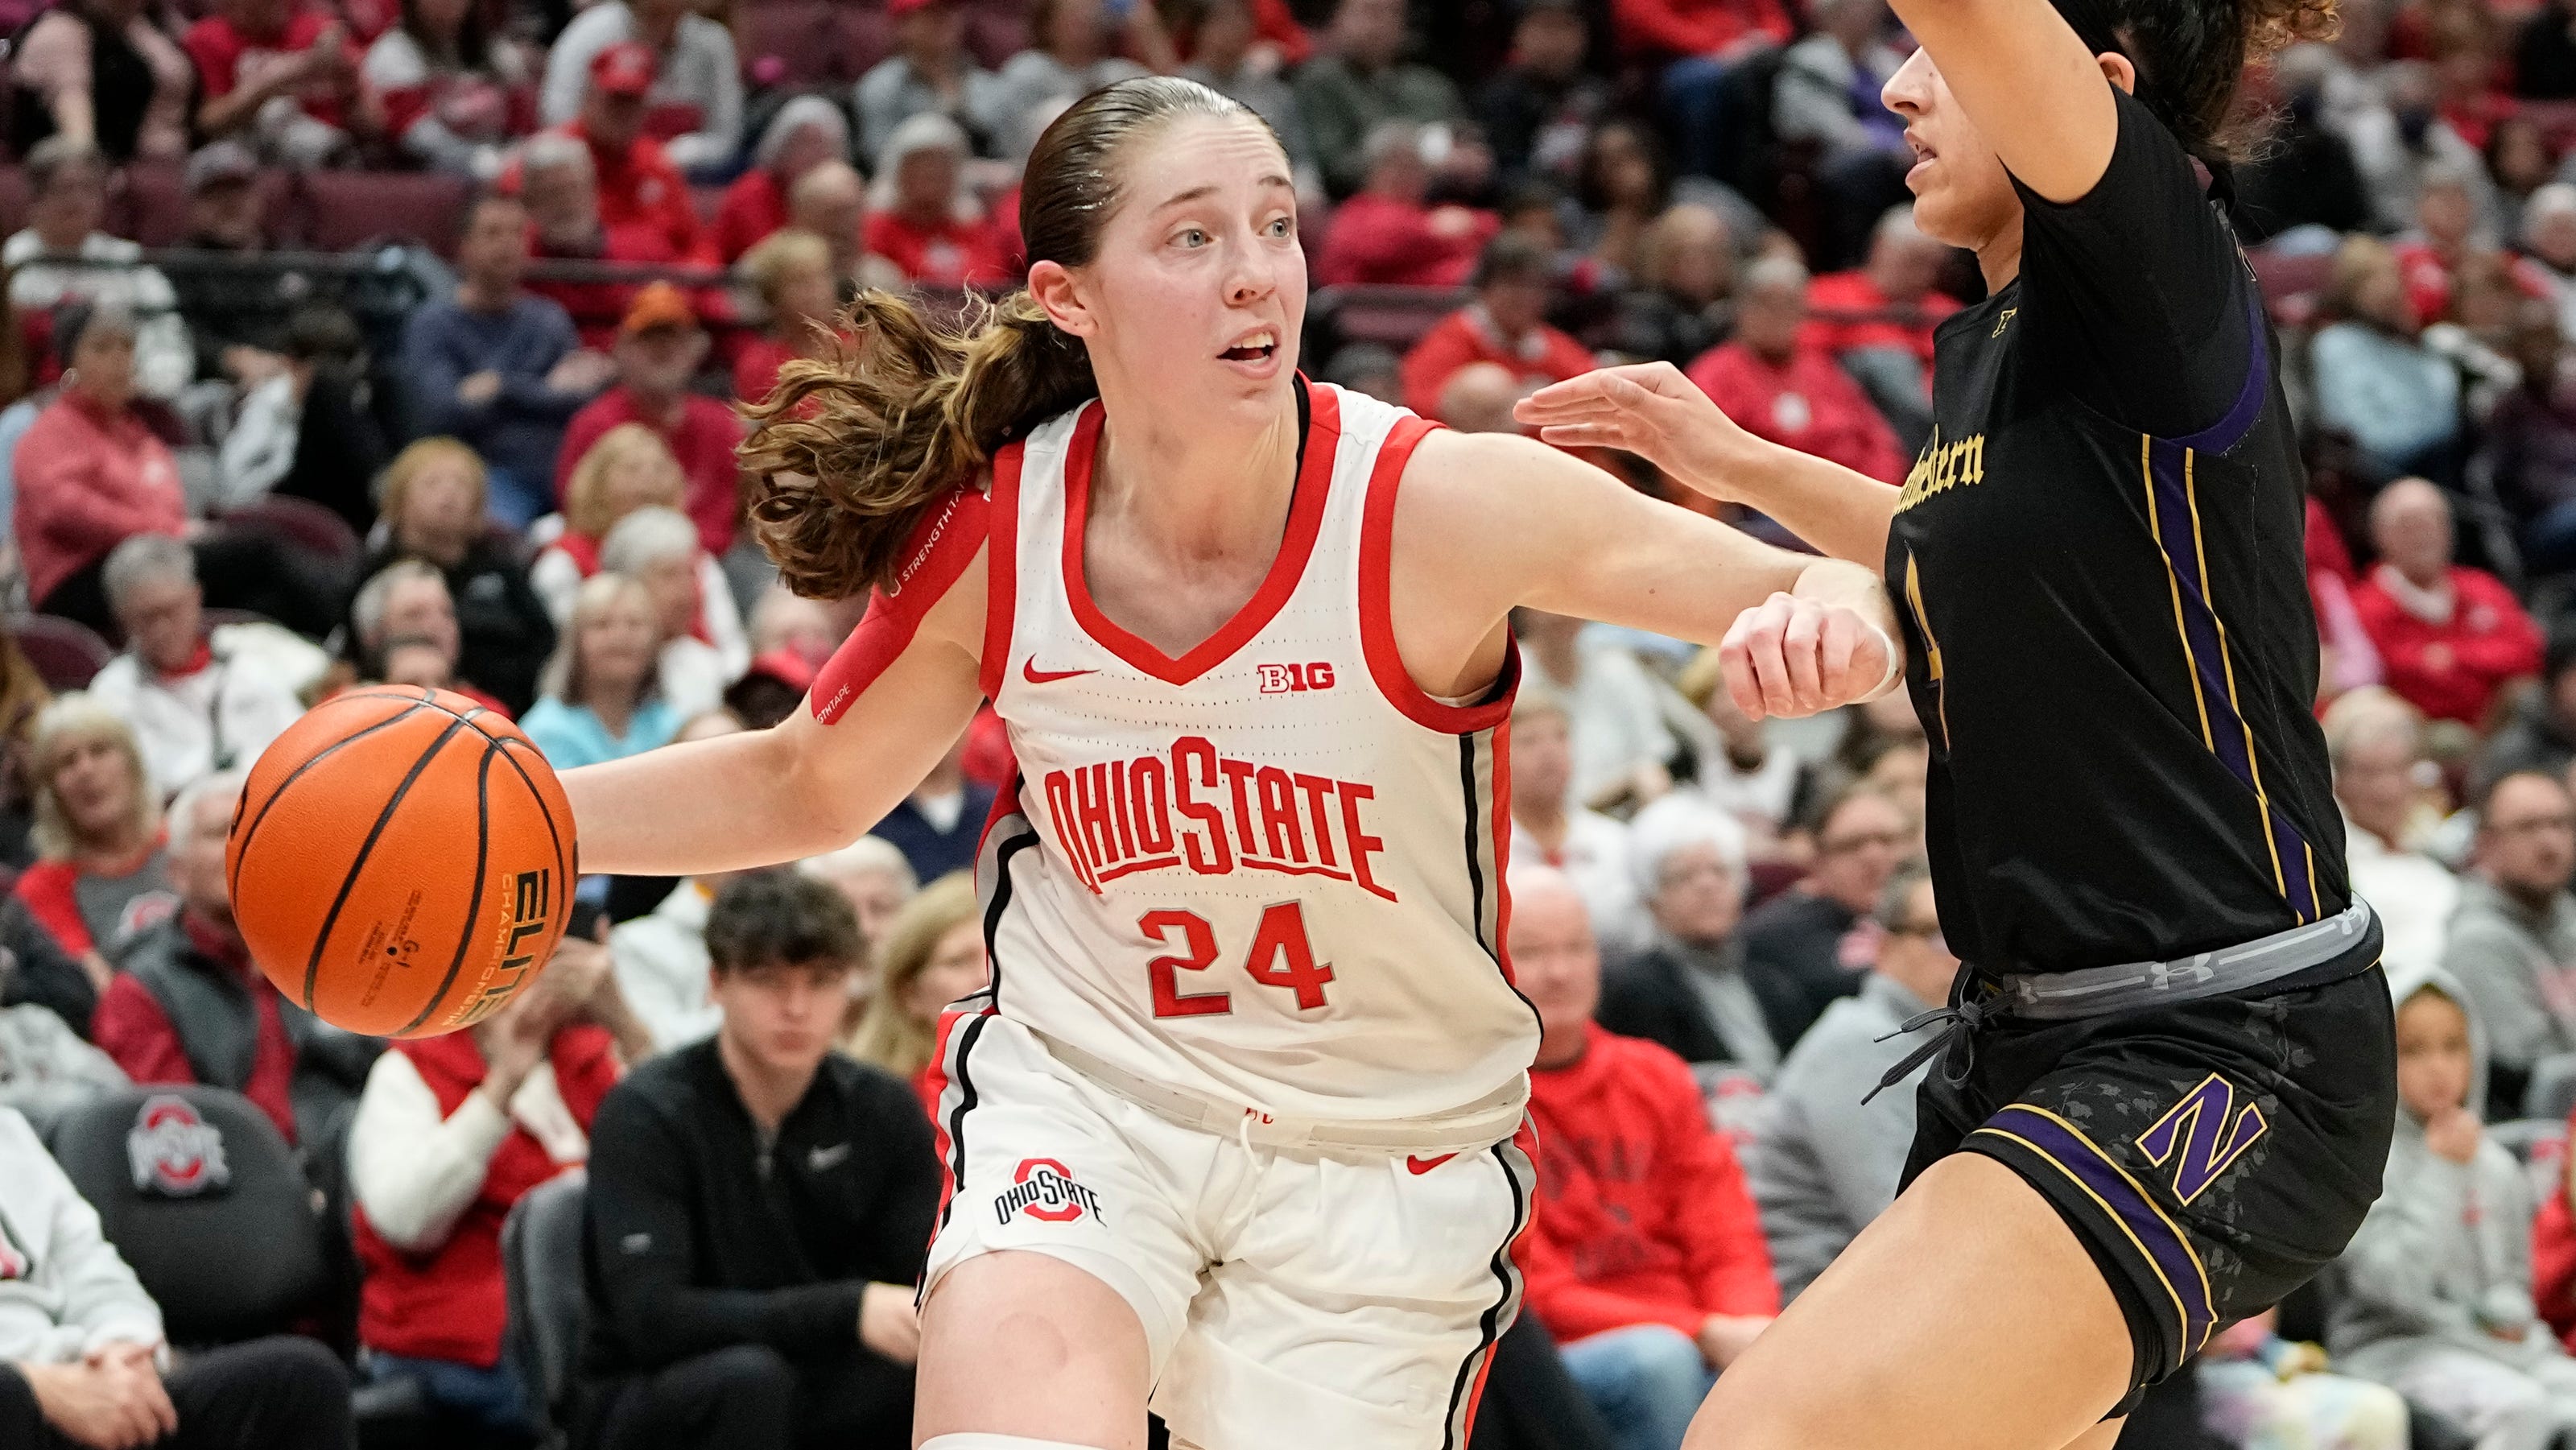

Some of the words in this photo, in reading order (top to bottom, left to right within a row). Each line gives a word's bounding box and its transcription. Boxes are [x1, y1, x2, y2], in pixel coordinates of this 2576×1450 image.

[902, 477, 966, 582] STRENGTHTA
[1044, 755, 1175, 894] OHIO
[1170, 736, 1399, 903] STATE
[454, 867, 551, 1025] ELITE
[1135, 898, 1337, 1020] 24
[993, 1179, 1042, 1225] OHIO
[1036, 1170, 1108, 1229] STATE
[2134, 1071, 2269, 1208] N
